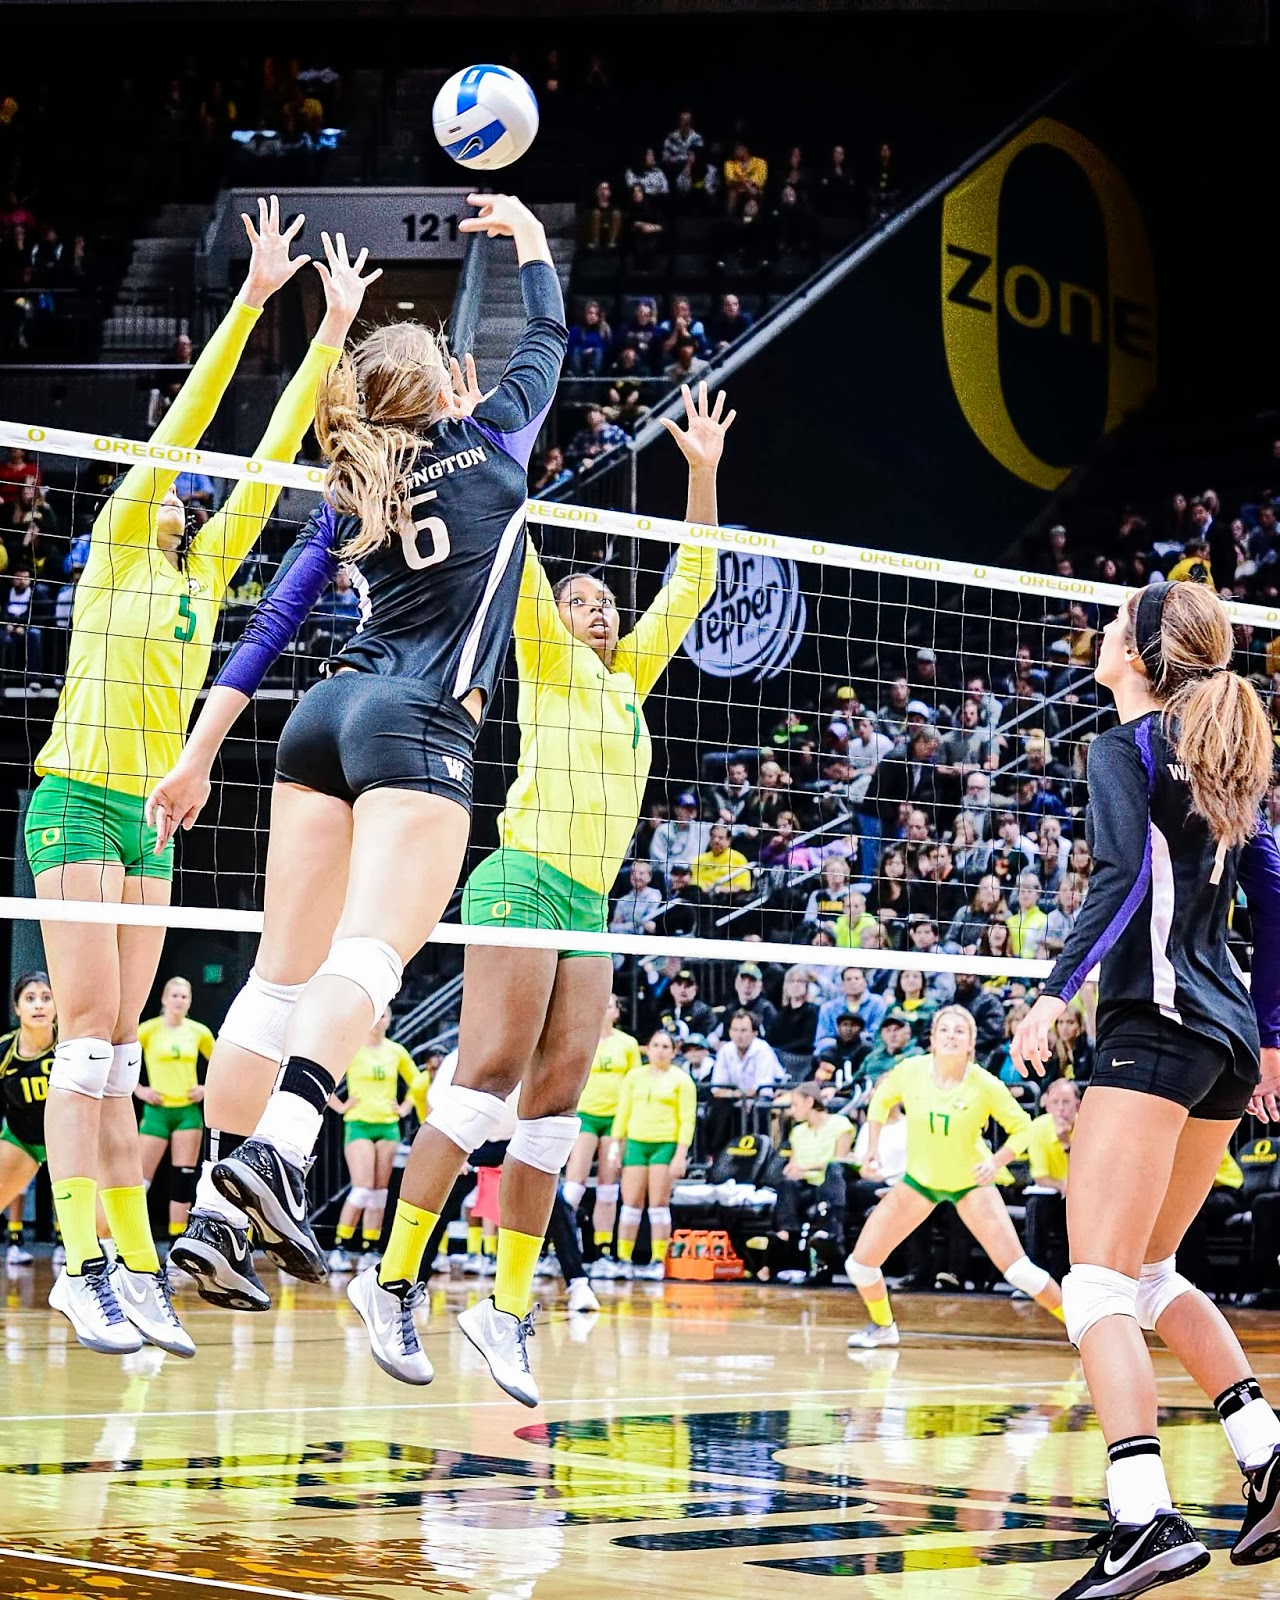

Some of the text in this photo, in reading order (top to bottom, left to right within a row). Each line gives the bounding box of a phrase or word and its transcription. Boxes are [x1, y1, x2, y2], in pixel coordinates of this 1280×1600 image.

[402, 214, 459, 241] 121
[405, 446, 488, 490] INGTON
[525, 503, 598, 523] REGON
[400, 490, 451, 571] 6
[174, 593, 197, 643] 5
[441, 755, 465, 781] W
[20, 1077, 48, 1103] 10
[929, 1111, 950, 1136] 17
